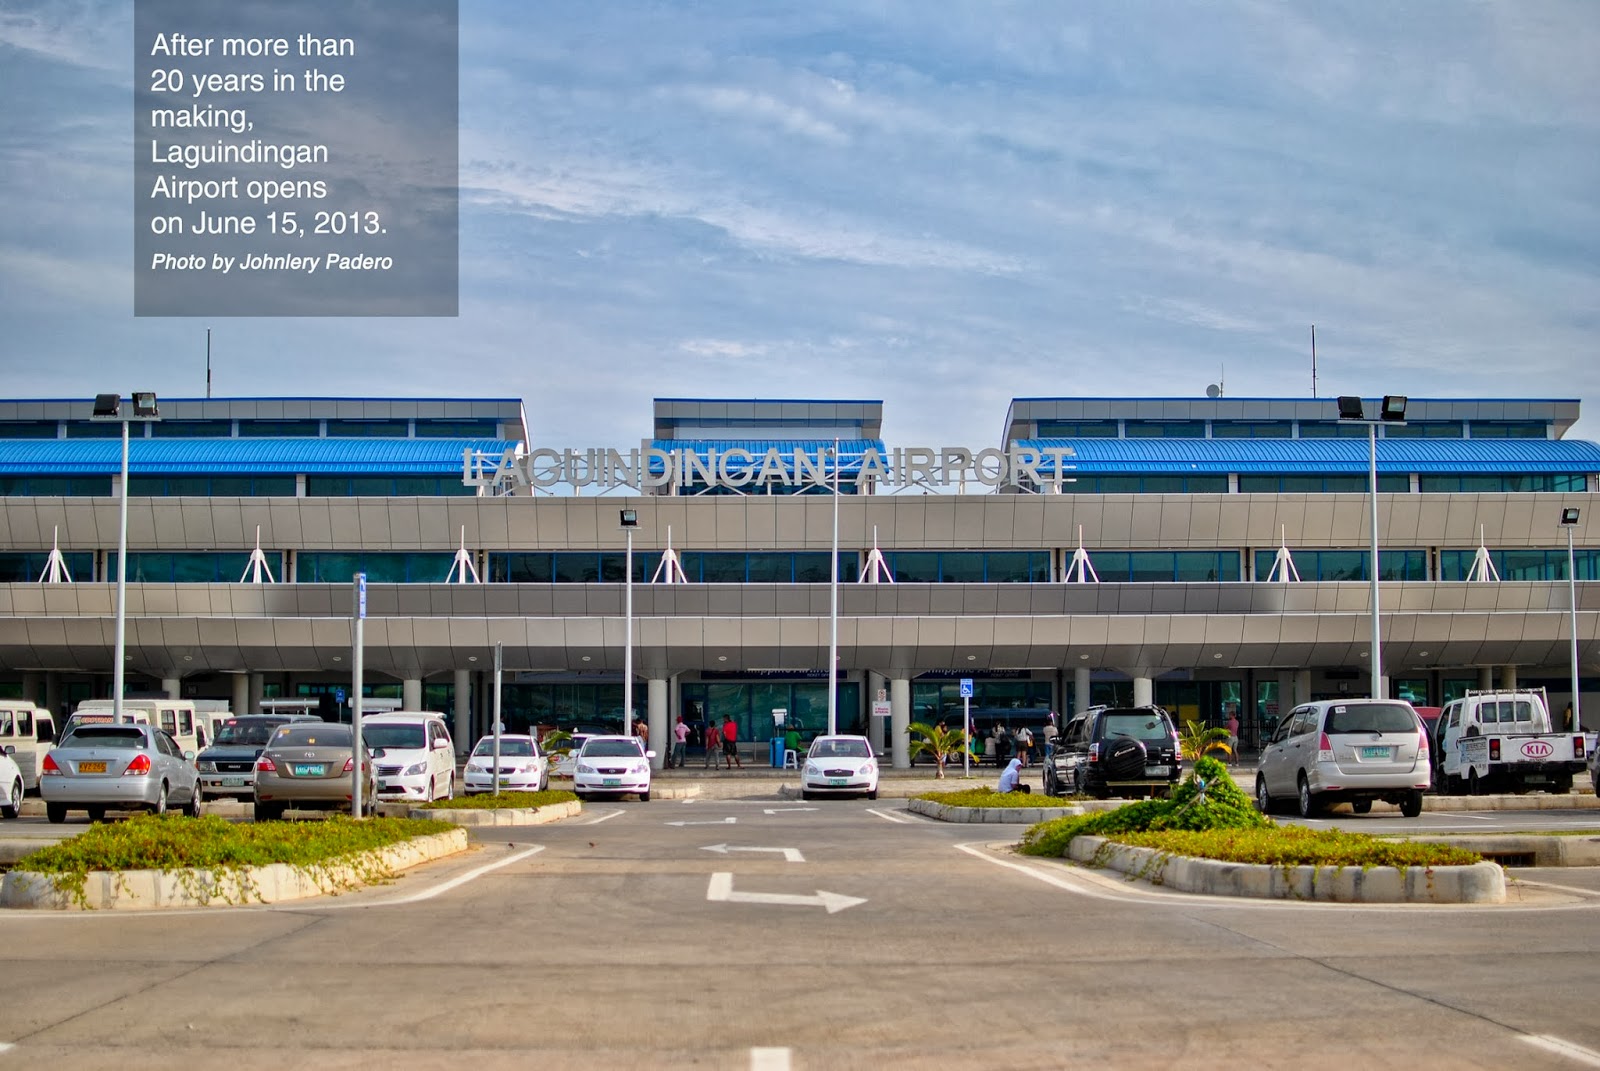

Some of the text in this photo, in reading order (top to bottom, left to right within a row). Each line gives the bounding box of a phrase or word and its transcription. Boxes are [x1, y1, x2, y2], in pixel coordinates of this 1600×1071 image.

[463, 447, 1075, 487] LAGUINDINGAN AIRPORT
[1526, 745, 1549, 755] KIA
